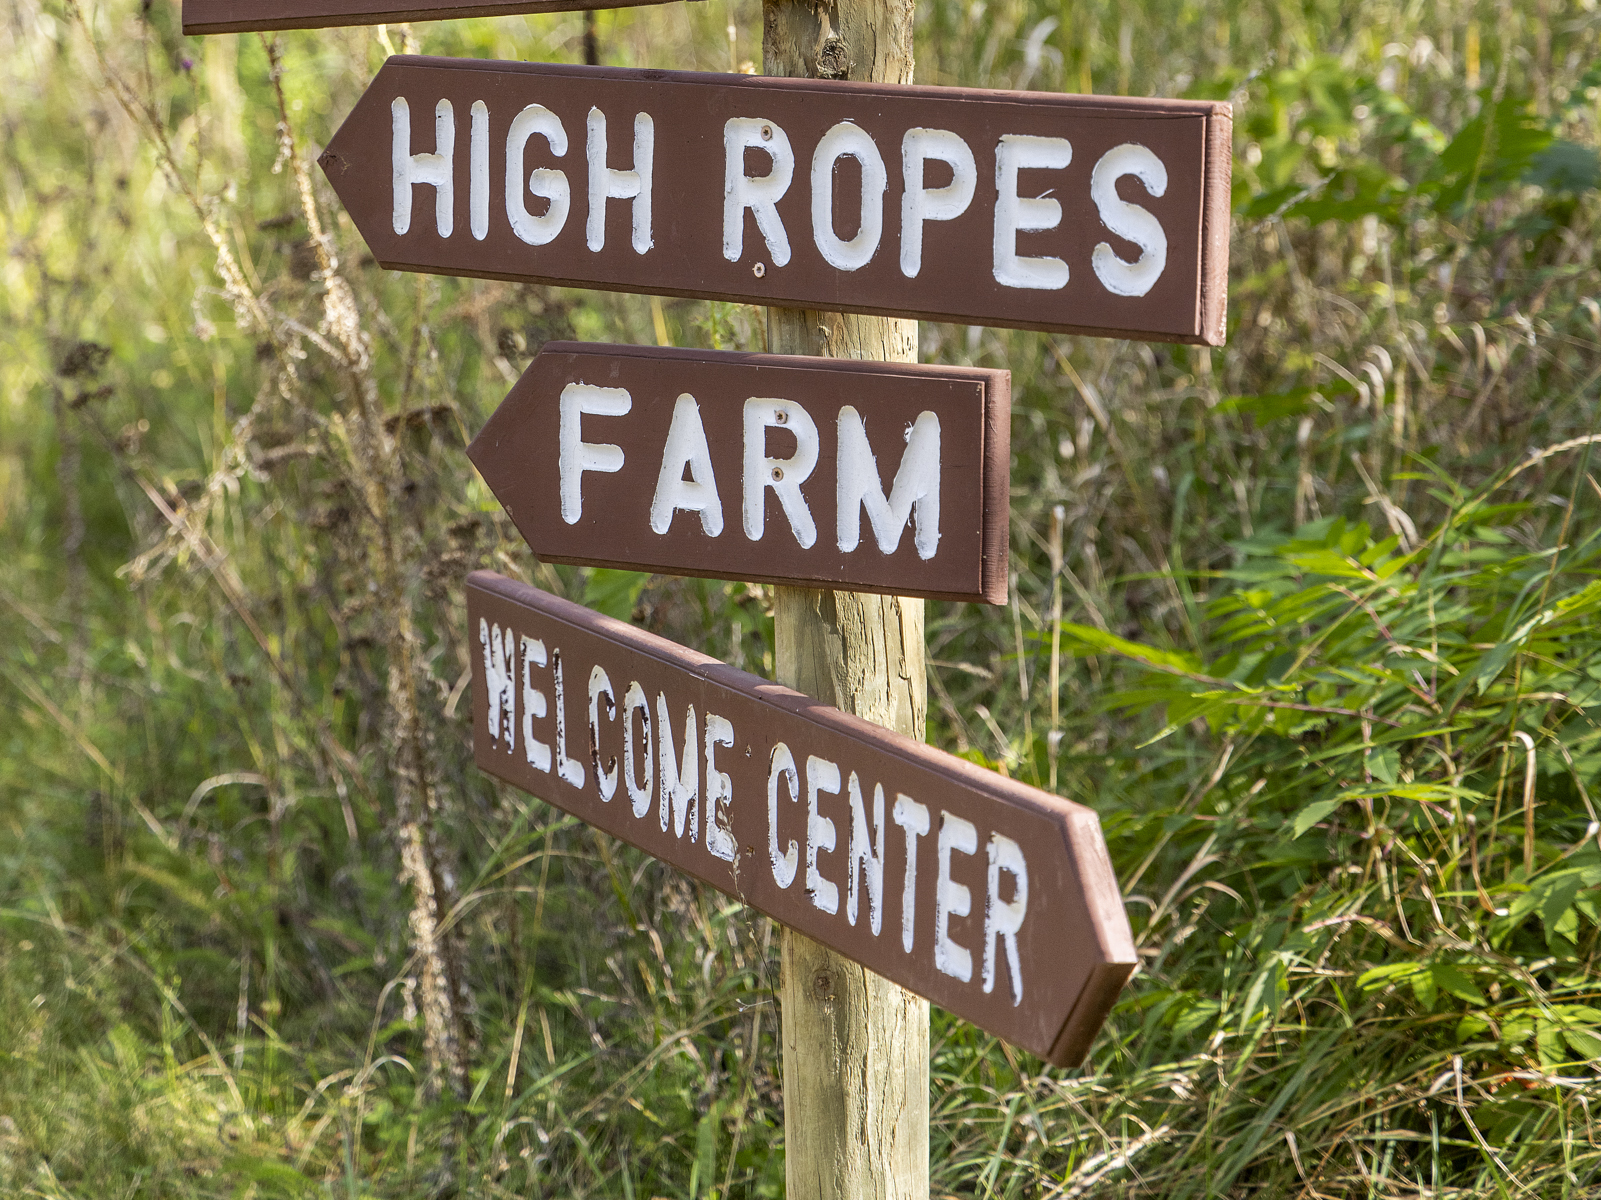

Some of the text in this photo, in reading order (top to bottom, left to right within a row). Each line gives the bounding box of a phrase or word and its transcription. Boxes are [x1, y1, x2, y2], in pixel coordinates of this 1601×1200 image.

[391, 96, 1168, 298] HIGH ROPES
[558, 381, 942, 561] FARM
[479, 617, 1029, 1008] WELCOME CENTER
